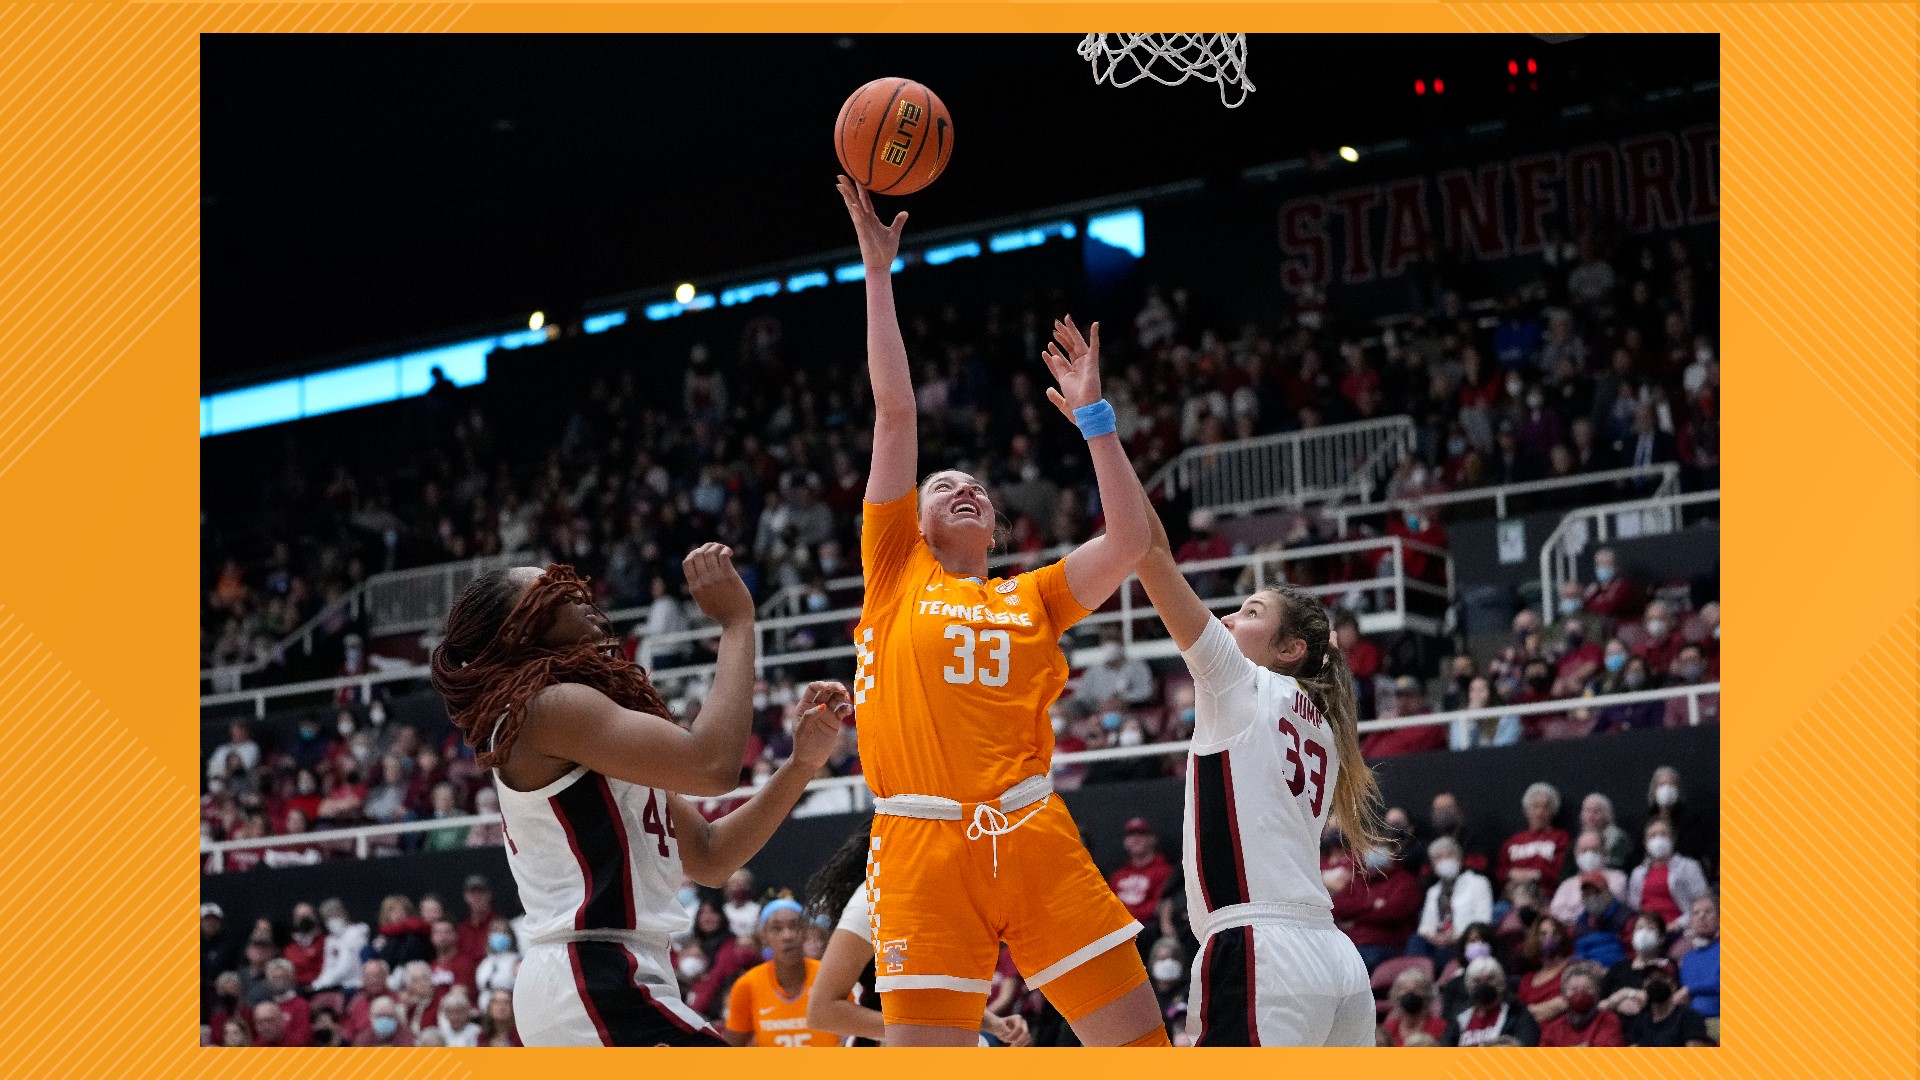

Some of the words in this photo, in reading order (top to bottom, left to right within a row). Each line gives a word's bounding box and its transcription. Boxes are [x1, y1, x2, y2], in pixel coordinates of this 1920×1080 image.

[885, 102, 923, 167] ELITE
[1278, 122, 1720, 296] STANFORD
[919, 600, 1033, 627] TENNESSEE
[944, 625, 1010, 687] 33
[1291, 690, 1323, 729] JUMP
[1278, 716, 1327, 818] 33
